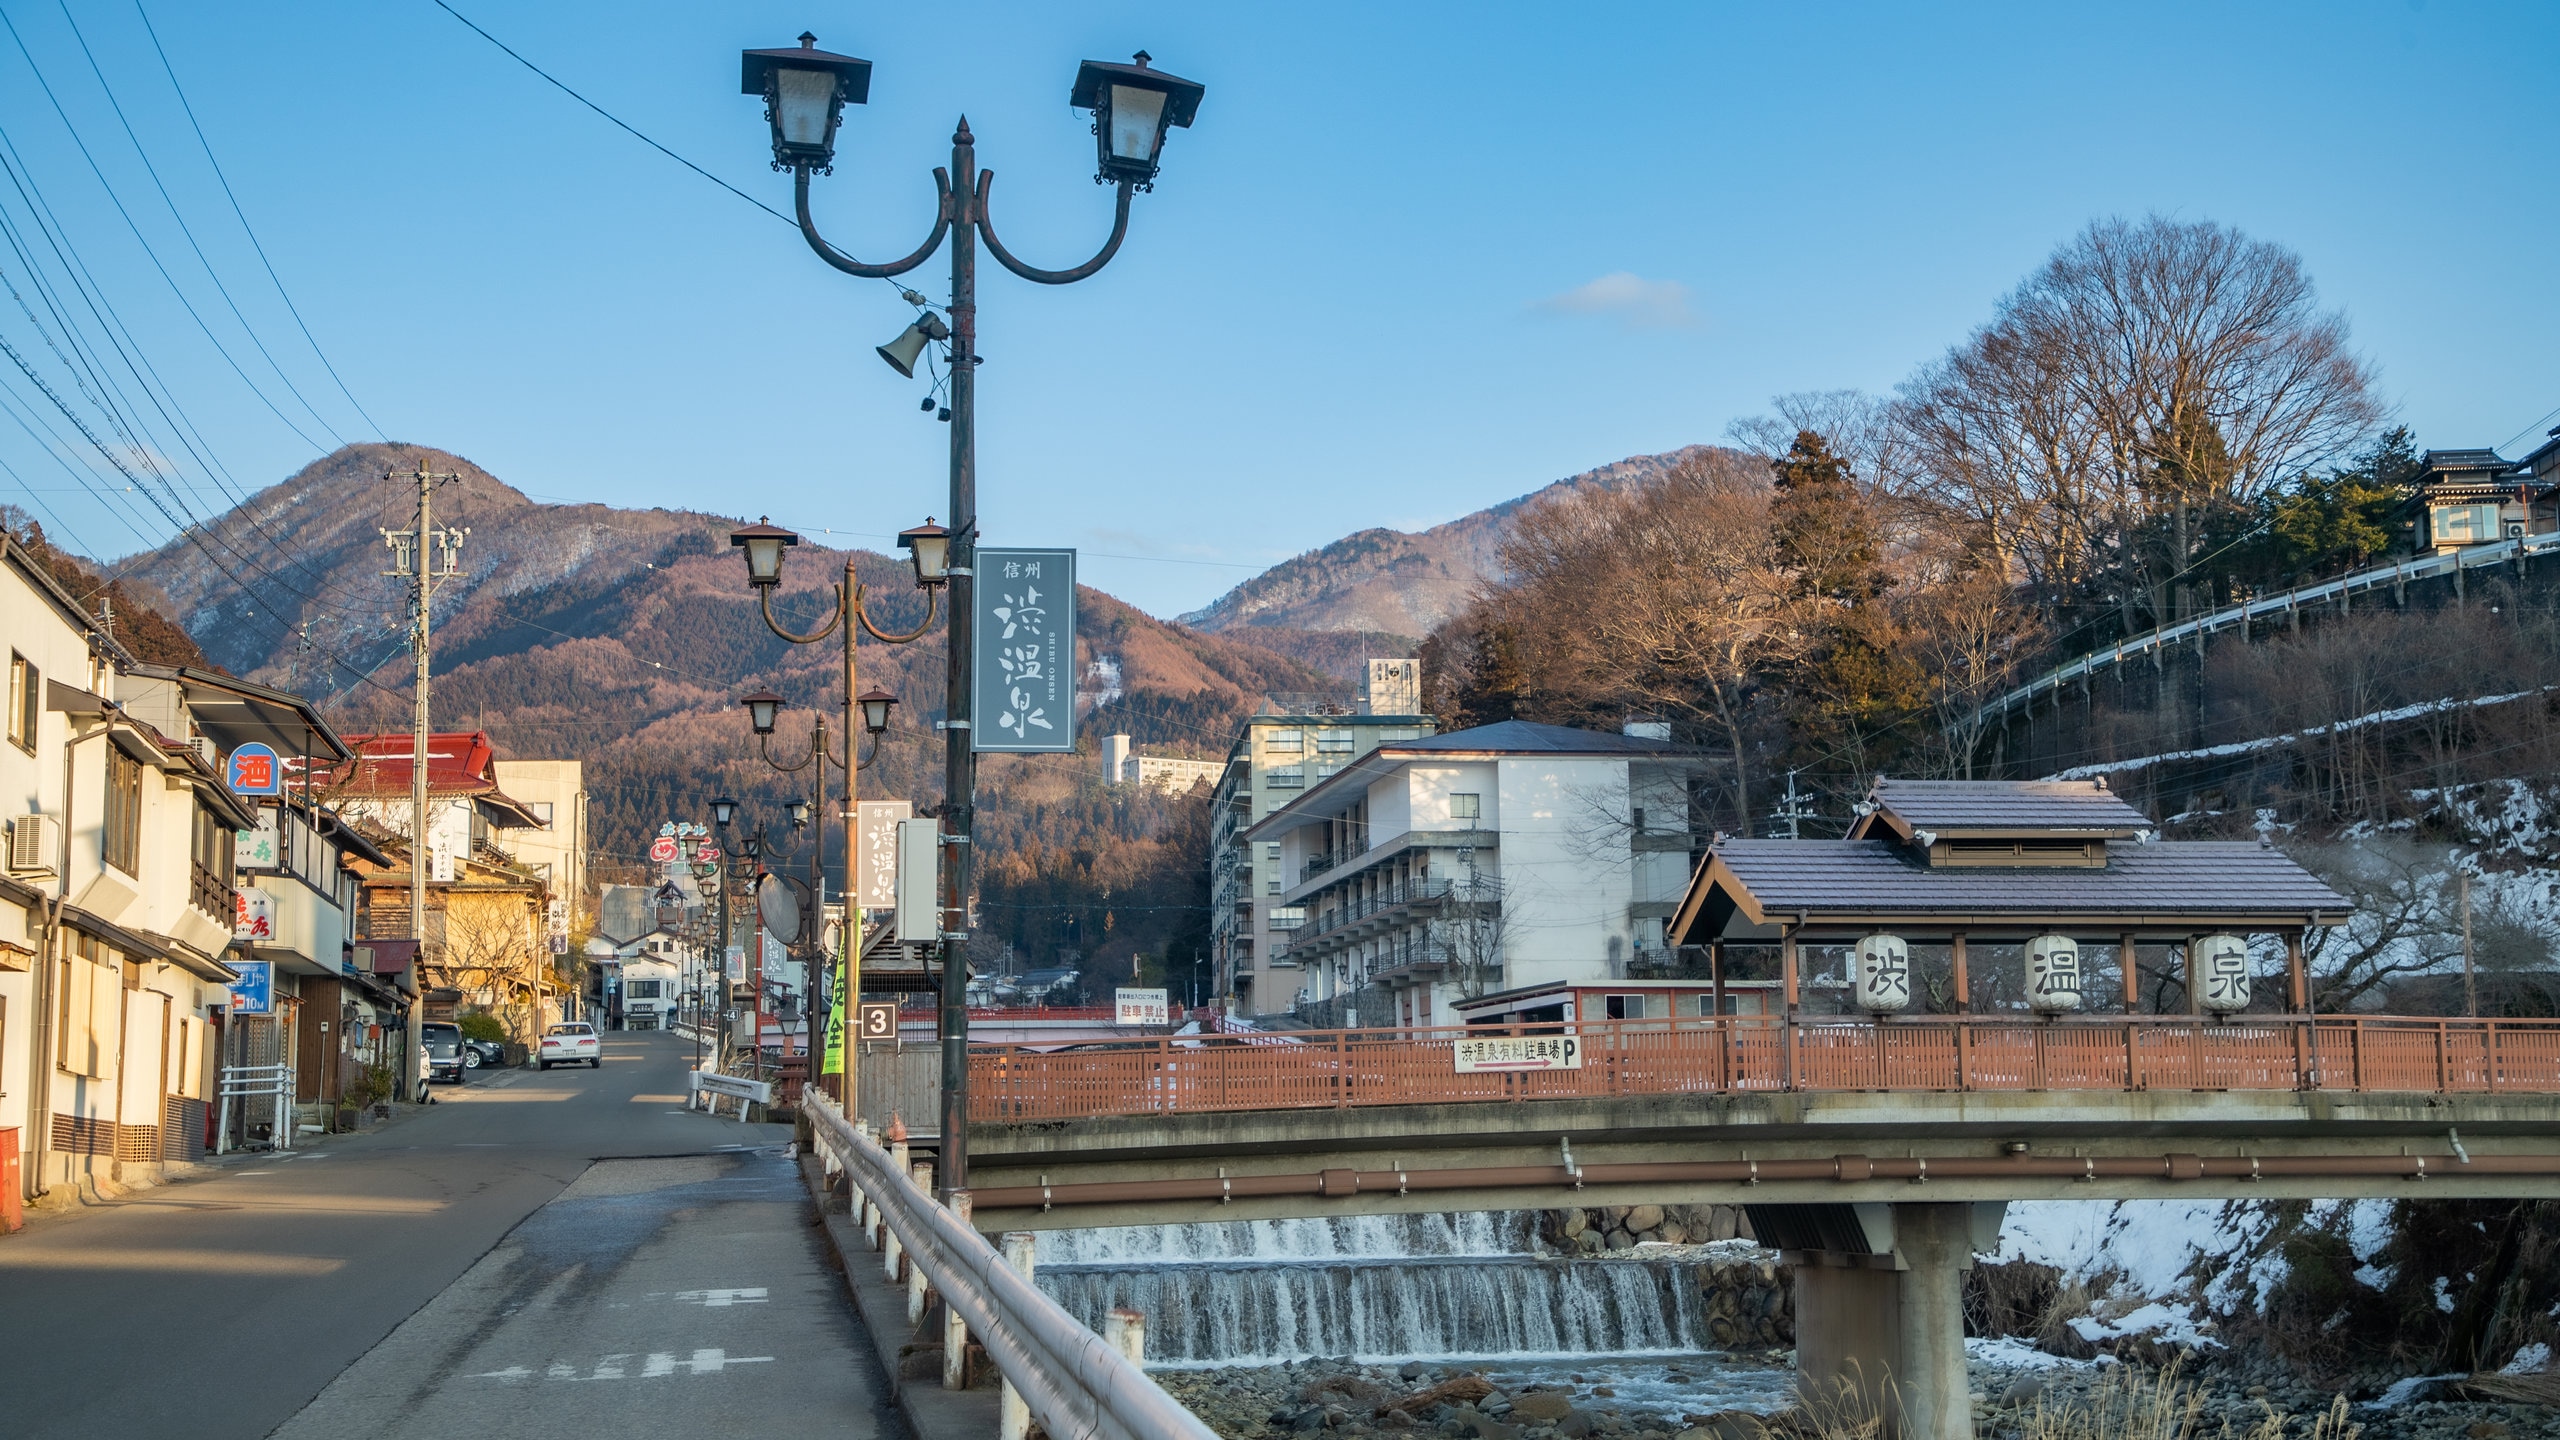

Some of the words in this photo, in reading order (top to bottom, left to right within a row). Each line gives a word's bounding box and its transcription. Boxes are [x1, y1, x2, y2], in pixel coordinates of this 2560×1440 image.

[1002, 560, 1041, 580] 信州
[1048, 631, 1056, 664] SHIBU
[993, 584, 1053, 739] 渋温泉
[1048, 666, 1056, 702] ONSEN
[235, 754, 272, 789] 酒
[873, 807, 894, 818] 信州
[660, 820, 708, 836] ホテル
[868, 820, 897, 902] 渋温泉
[1865, 947, 1908, 996] 渋
[2033, 950, 2081, 996] 温
[2208, 946, 2249, 999] 泉
[729, 1011, 736, 1019] 4
[870, 1009, 887, 1034] 3
[1121, 1004, 1165, 1018] 駐車禁止
[1461, 1040, 1560, 1062] 渋温泉有料駐車場
[1563, 1039, 1576, 1066] P
